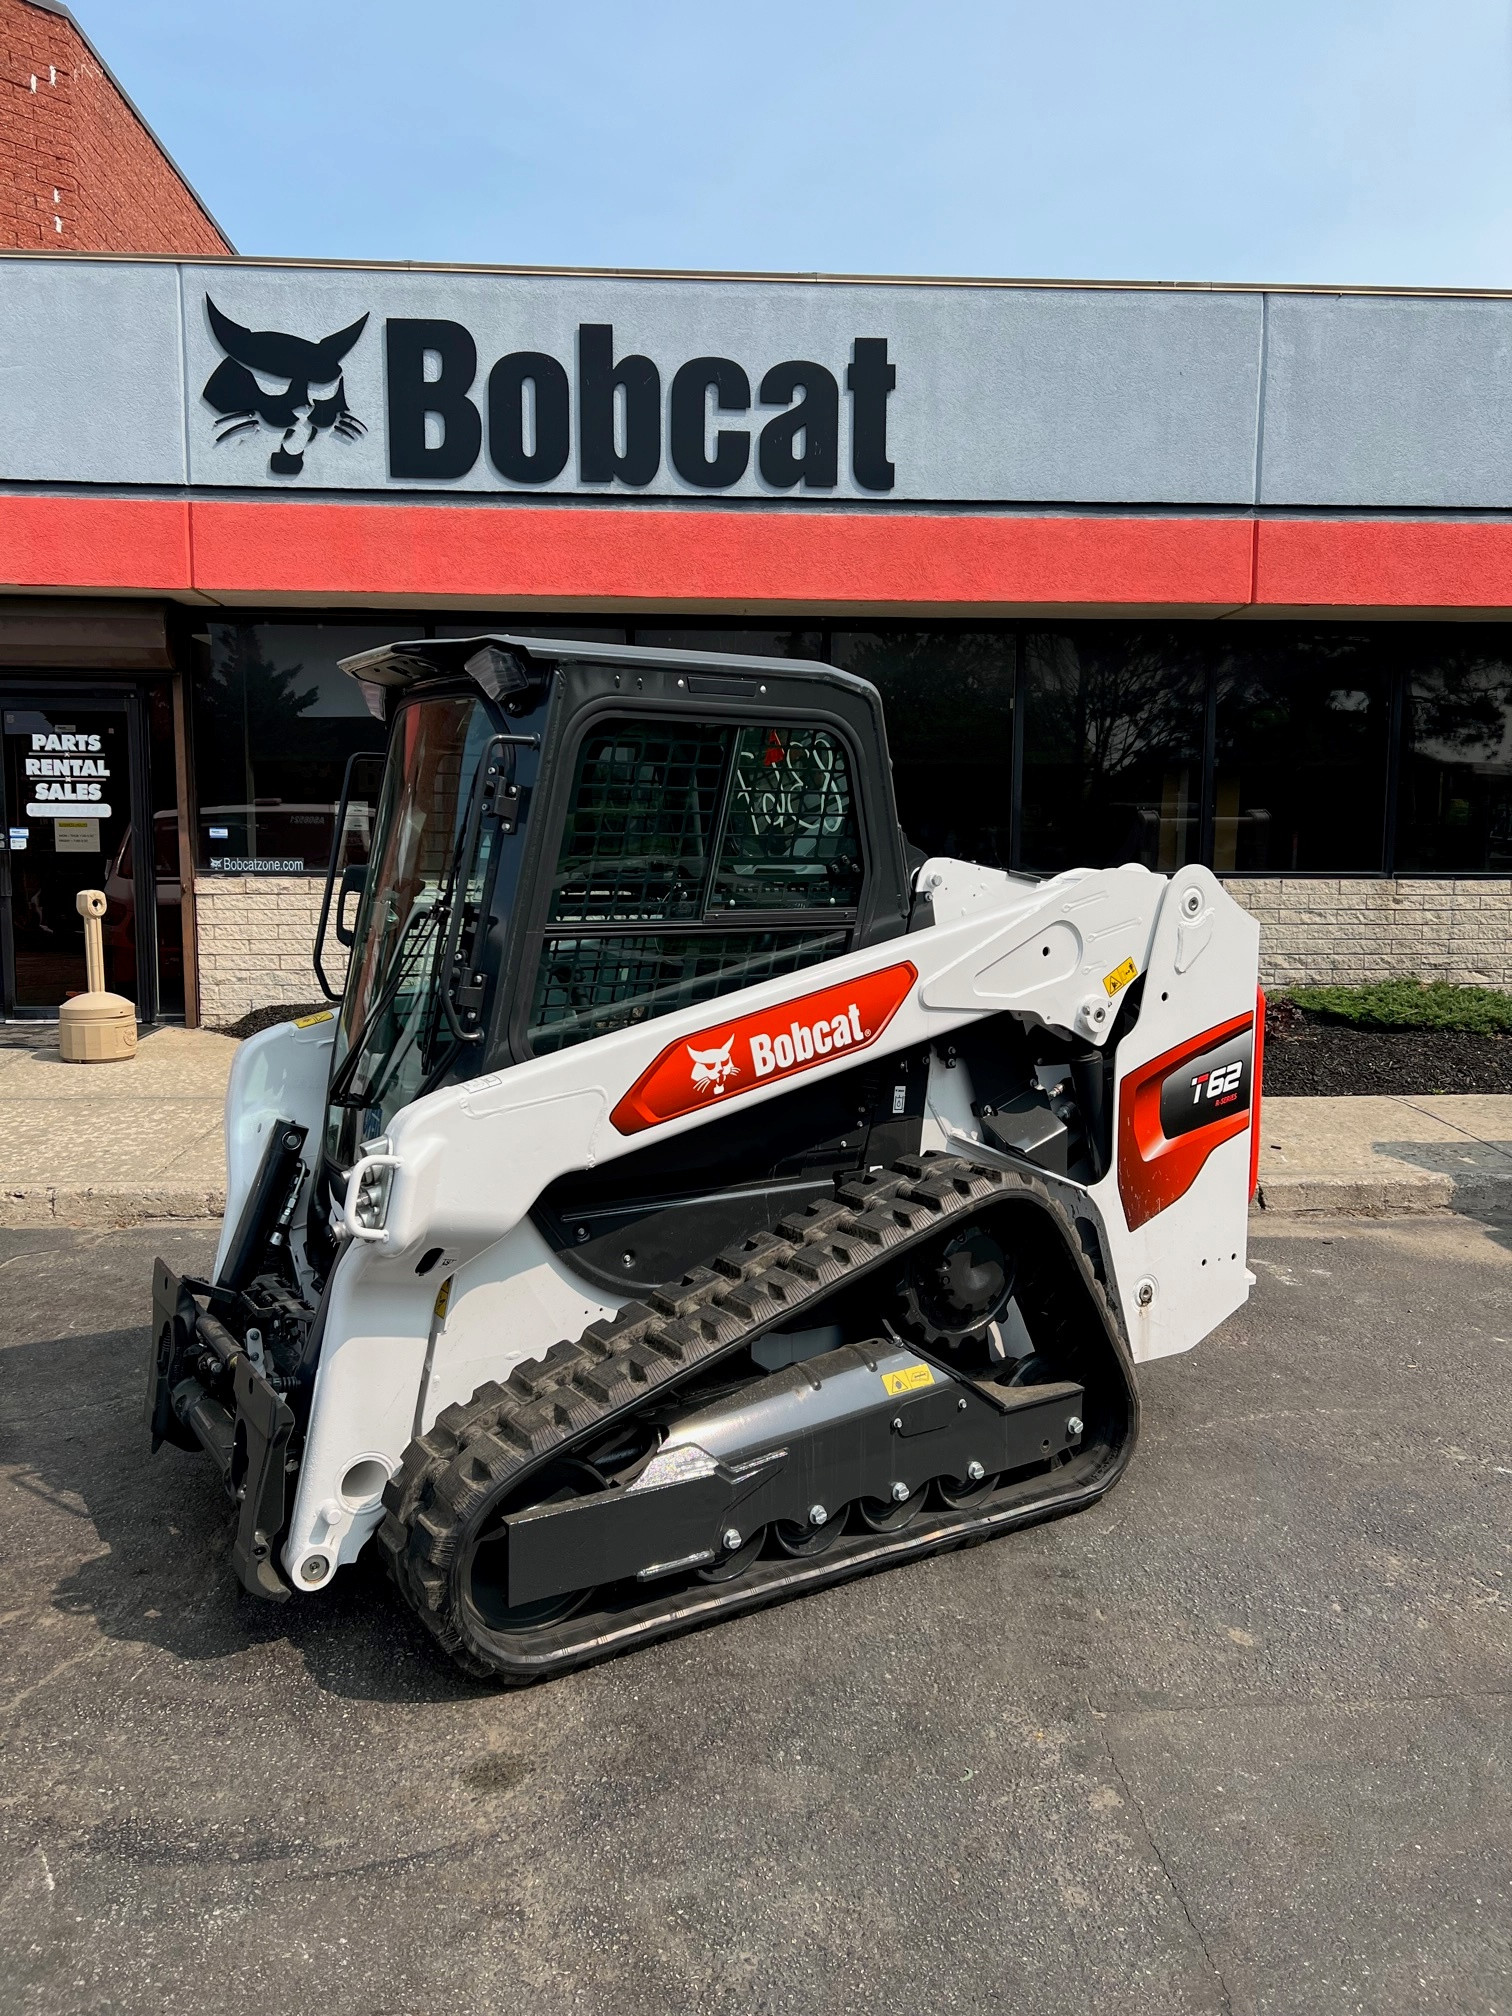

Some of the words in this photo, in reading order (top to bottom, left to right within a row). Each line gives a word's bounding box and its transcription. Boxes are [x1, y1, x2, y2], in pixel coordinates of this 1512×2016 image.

[386, 318, 896, 490] Bobcat
[32, 734, 101, 751] PARTS
[25, 759, 110, 776] RENTAL
[35, 783, 101, 801] SALES
[223, 857, 304, 871] Bobcatzone.com
[1191, 1061, 1242, 1104] T62
